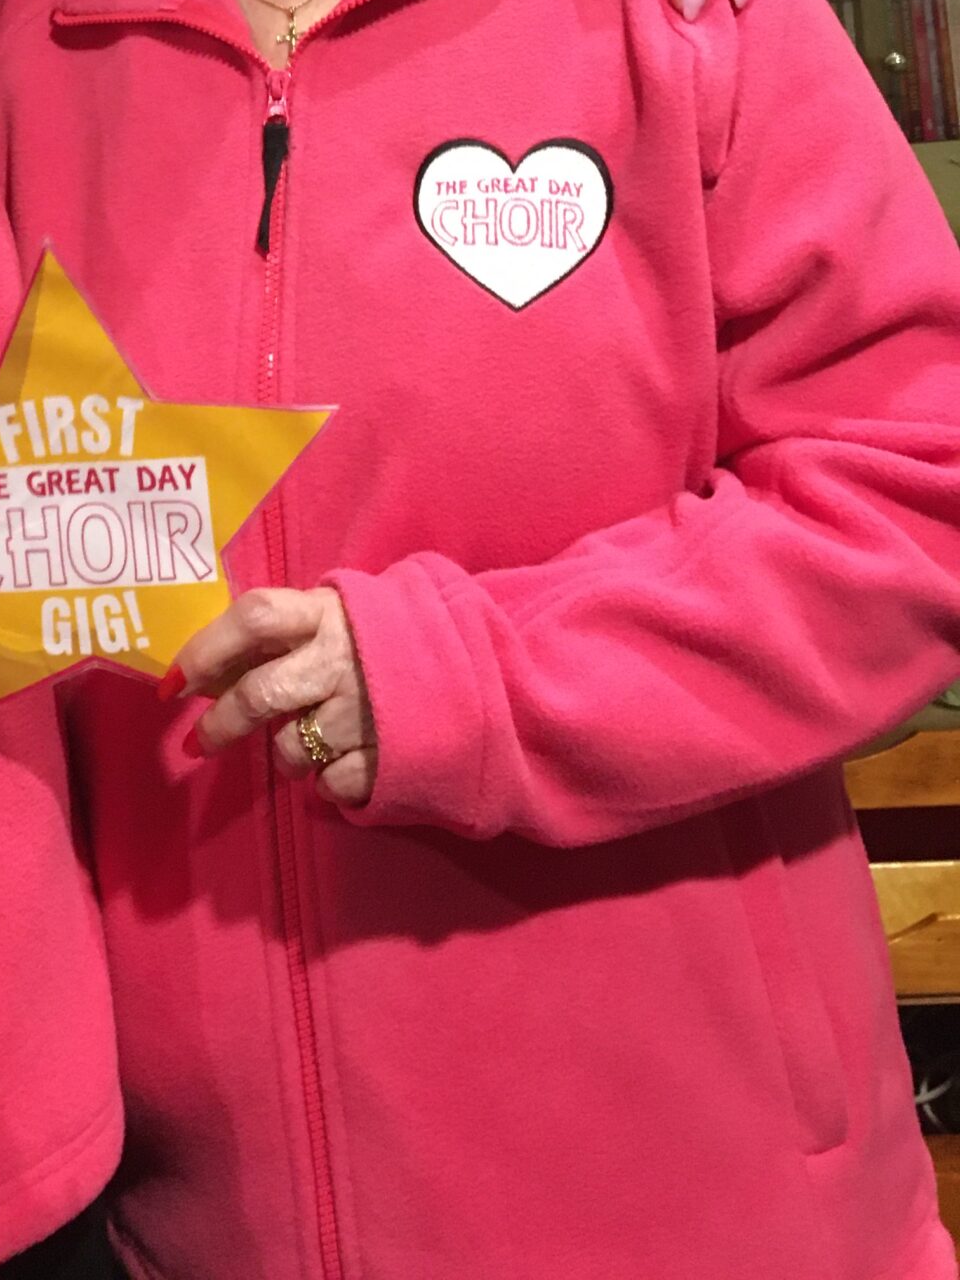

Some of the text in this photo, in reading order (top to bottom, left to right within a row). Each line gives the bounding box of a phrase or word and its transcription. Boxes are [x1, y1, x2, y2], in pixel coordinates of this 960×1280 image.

[435, 177, 583, 198] THE GREAT DAY
[431, 198, 587, 252] CHOIR
[27, 466, 120, 498] GREAT
[136, 463, 196, 492] DAY
[40, 590, 151, 656] GIG!
